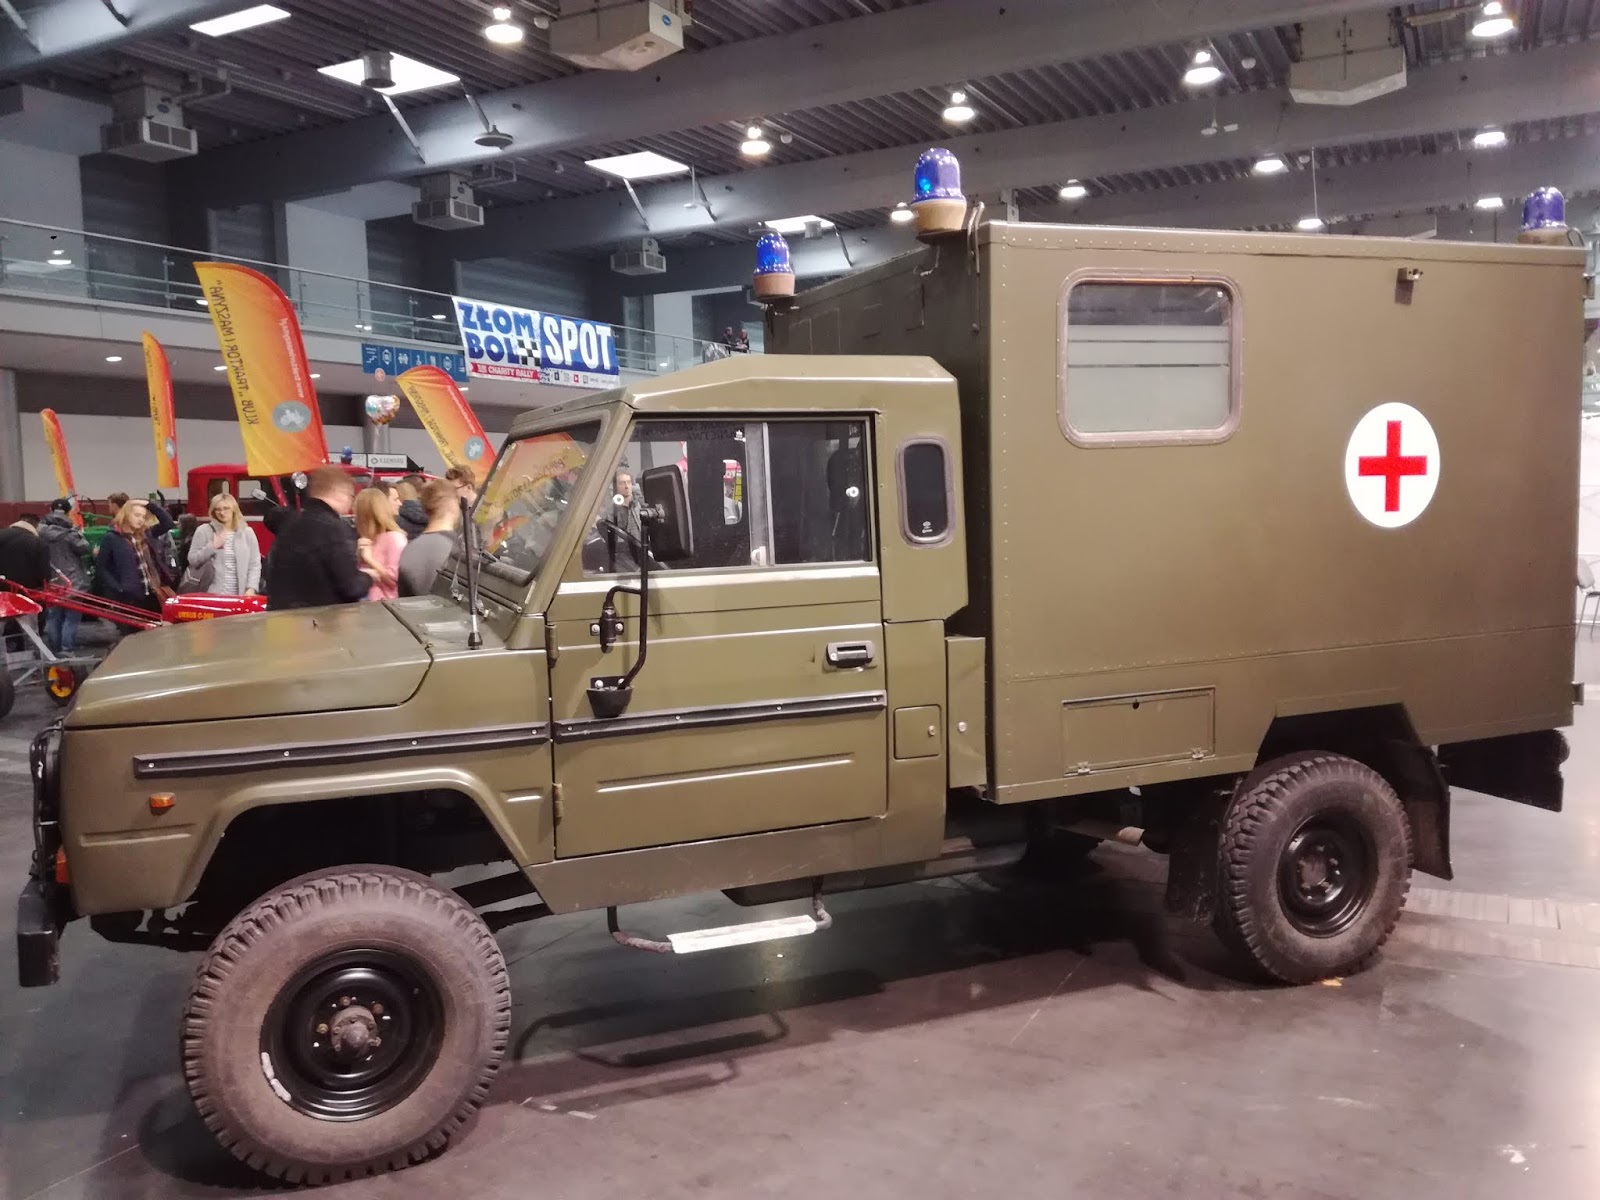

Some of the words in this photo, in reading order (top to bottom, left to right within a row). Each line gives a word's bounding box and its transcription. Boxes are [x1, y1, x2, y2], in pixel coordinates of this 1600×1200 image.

[457, 301, 535, 341] ZŁOM
[464, 331, 521, 365] BOL
[542, 314, 612, 371] SPOT
[488, 364, 515, 377] CHARITY
[515, 367, 535, 379] RALLY
